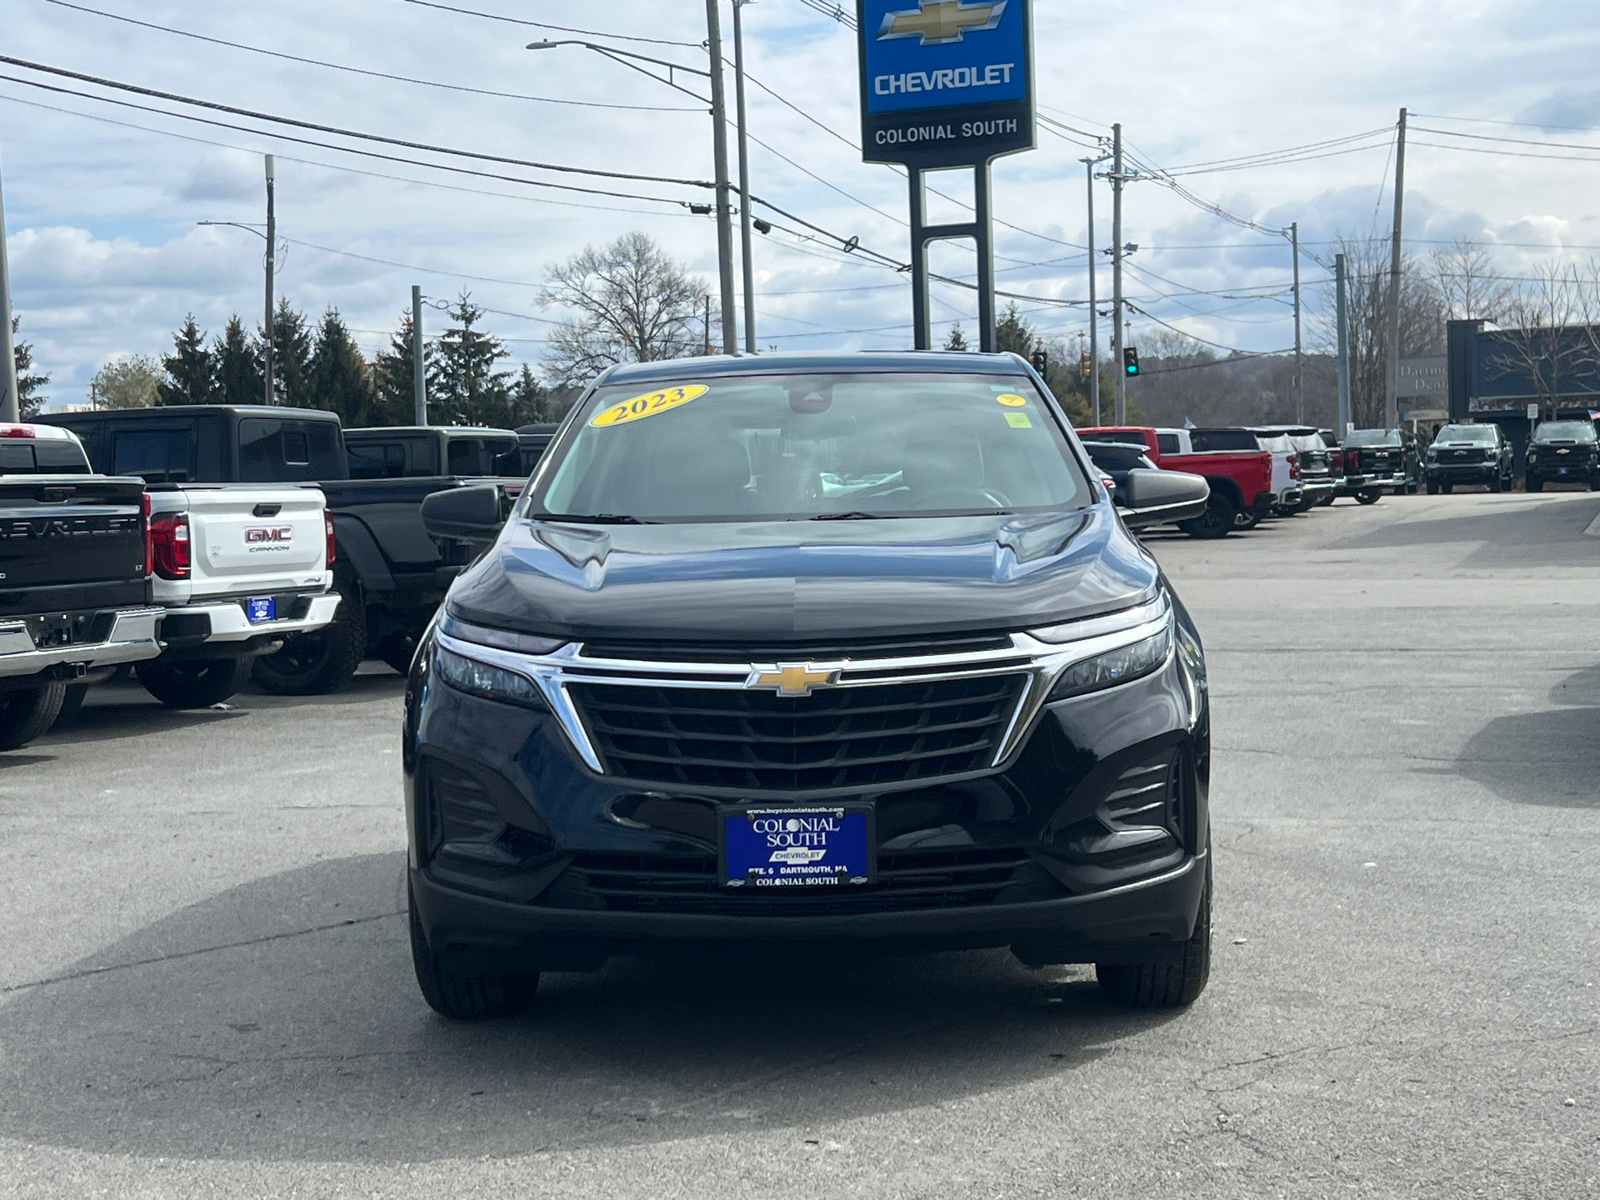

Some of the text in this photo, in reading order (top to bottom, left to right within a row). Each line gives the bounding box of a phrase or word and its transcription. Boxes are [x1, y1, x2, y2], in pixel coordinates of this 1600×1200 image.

[874, 63, 1014, 95] CHEVROLET
[875, 119, 1017, 144] COLONIAL SOUTH
[613, 388, 685, 422] 2023
[246, 528, 292, 543] GMC
[753, 818, 840, 833] COLONIAL
[767, 832, 826, 847] SOUTH
[775, 851, 820, 859] CHEVROLET
[780, 866, 833, 874] DARTMOUTH,
[756, 876, 838, 886] COLONIAL SOUTH
